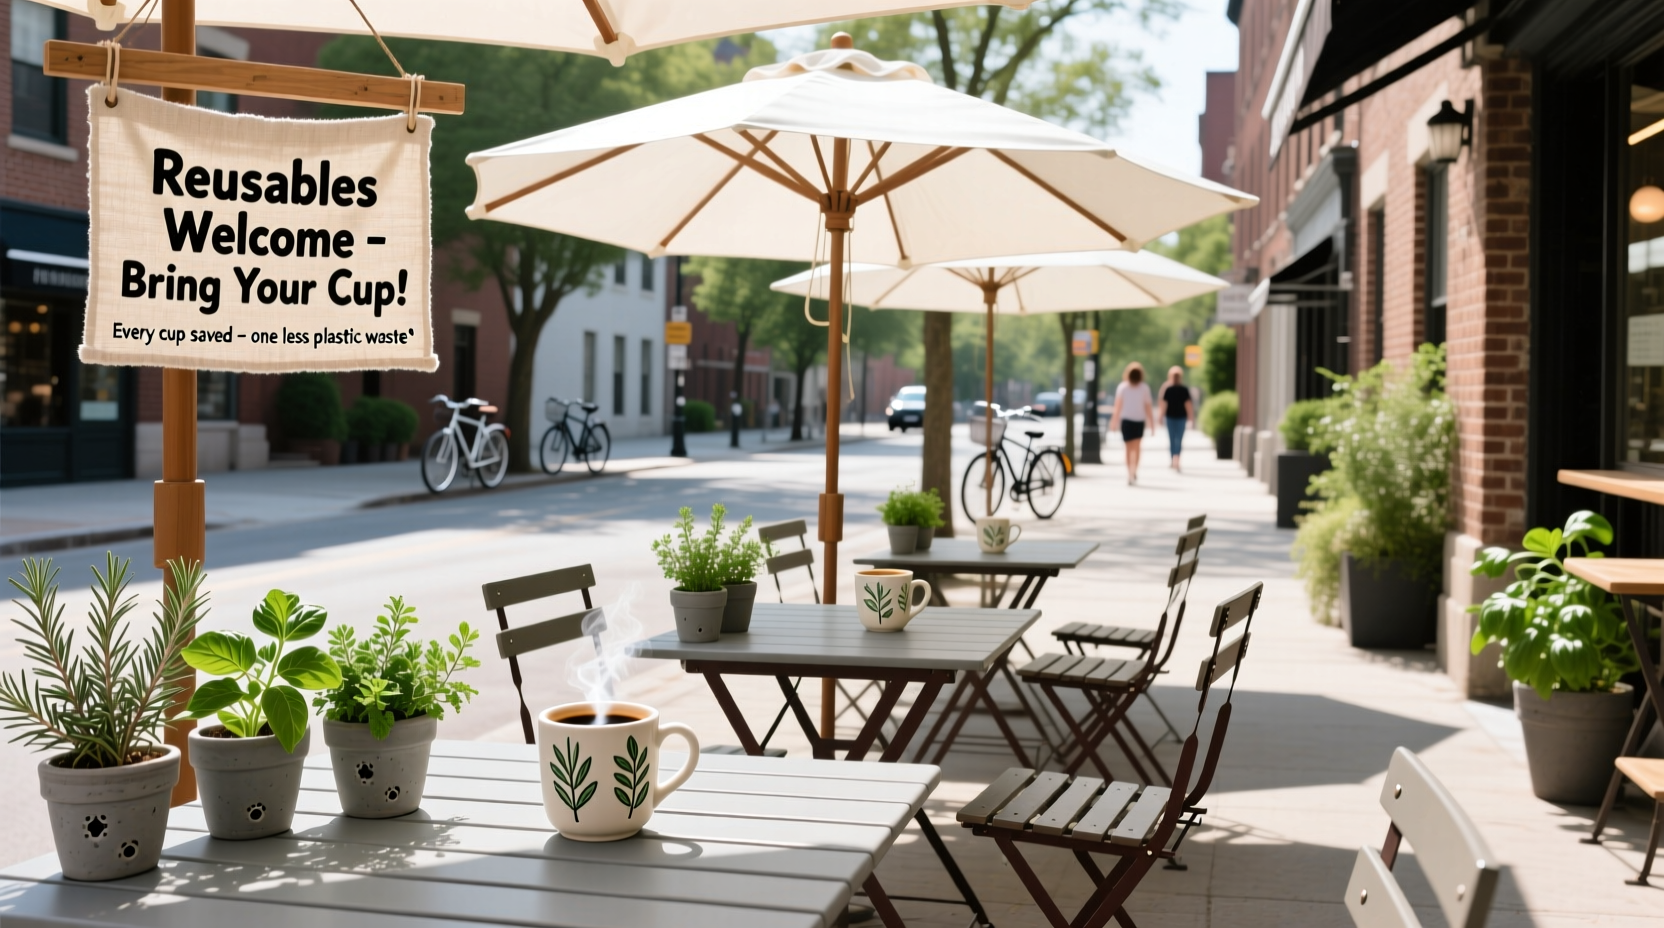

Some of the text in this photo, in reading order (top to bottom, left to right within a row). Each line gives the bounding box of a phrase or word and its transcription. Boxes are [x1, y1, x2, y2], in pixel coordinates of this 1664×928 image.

[152, 147, 378, 208] Reusables
[163, 207, 355, 259] Welcome
[121, 259, 221, 315] Bring
[233, 266, 317, 306] Your
[327, 268, 408, 318] Cup!
[112, 322, 156, 346] Every
[158, 328, 186, 347] cup
[190, 325, 233, 343] saved
[250, 331, 278, 344] one
[282, 326, 310, 345] less
[313, 326, 362, 350] plastic
